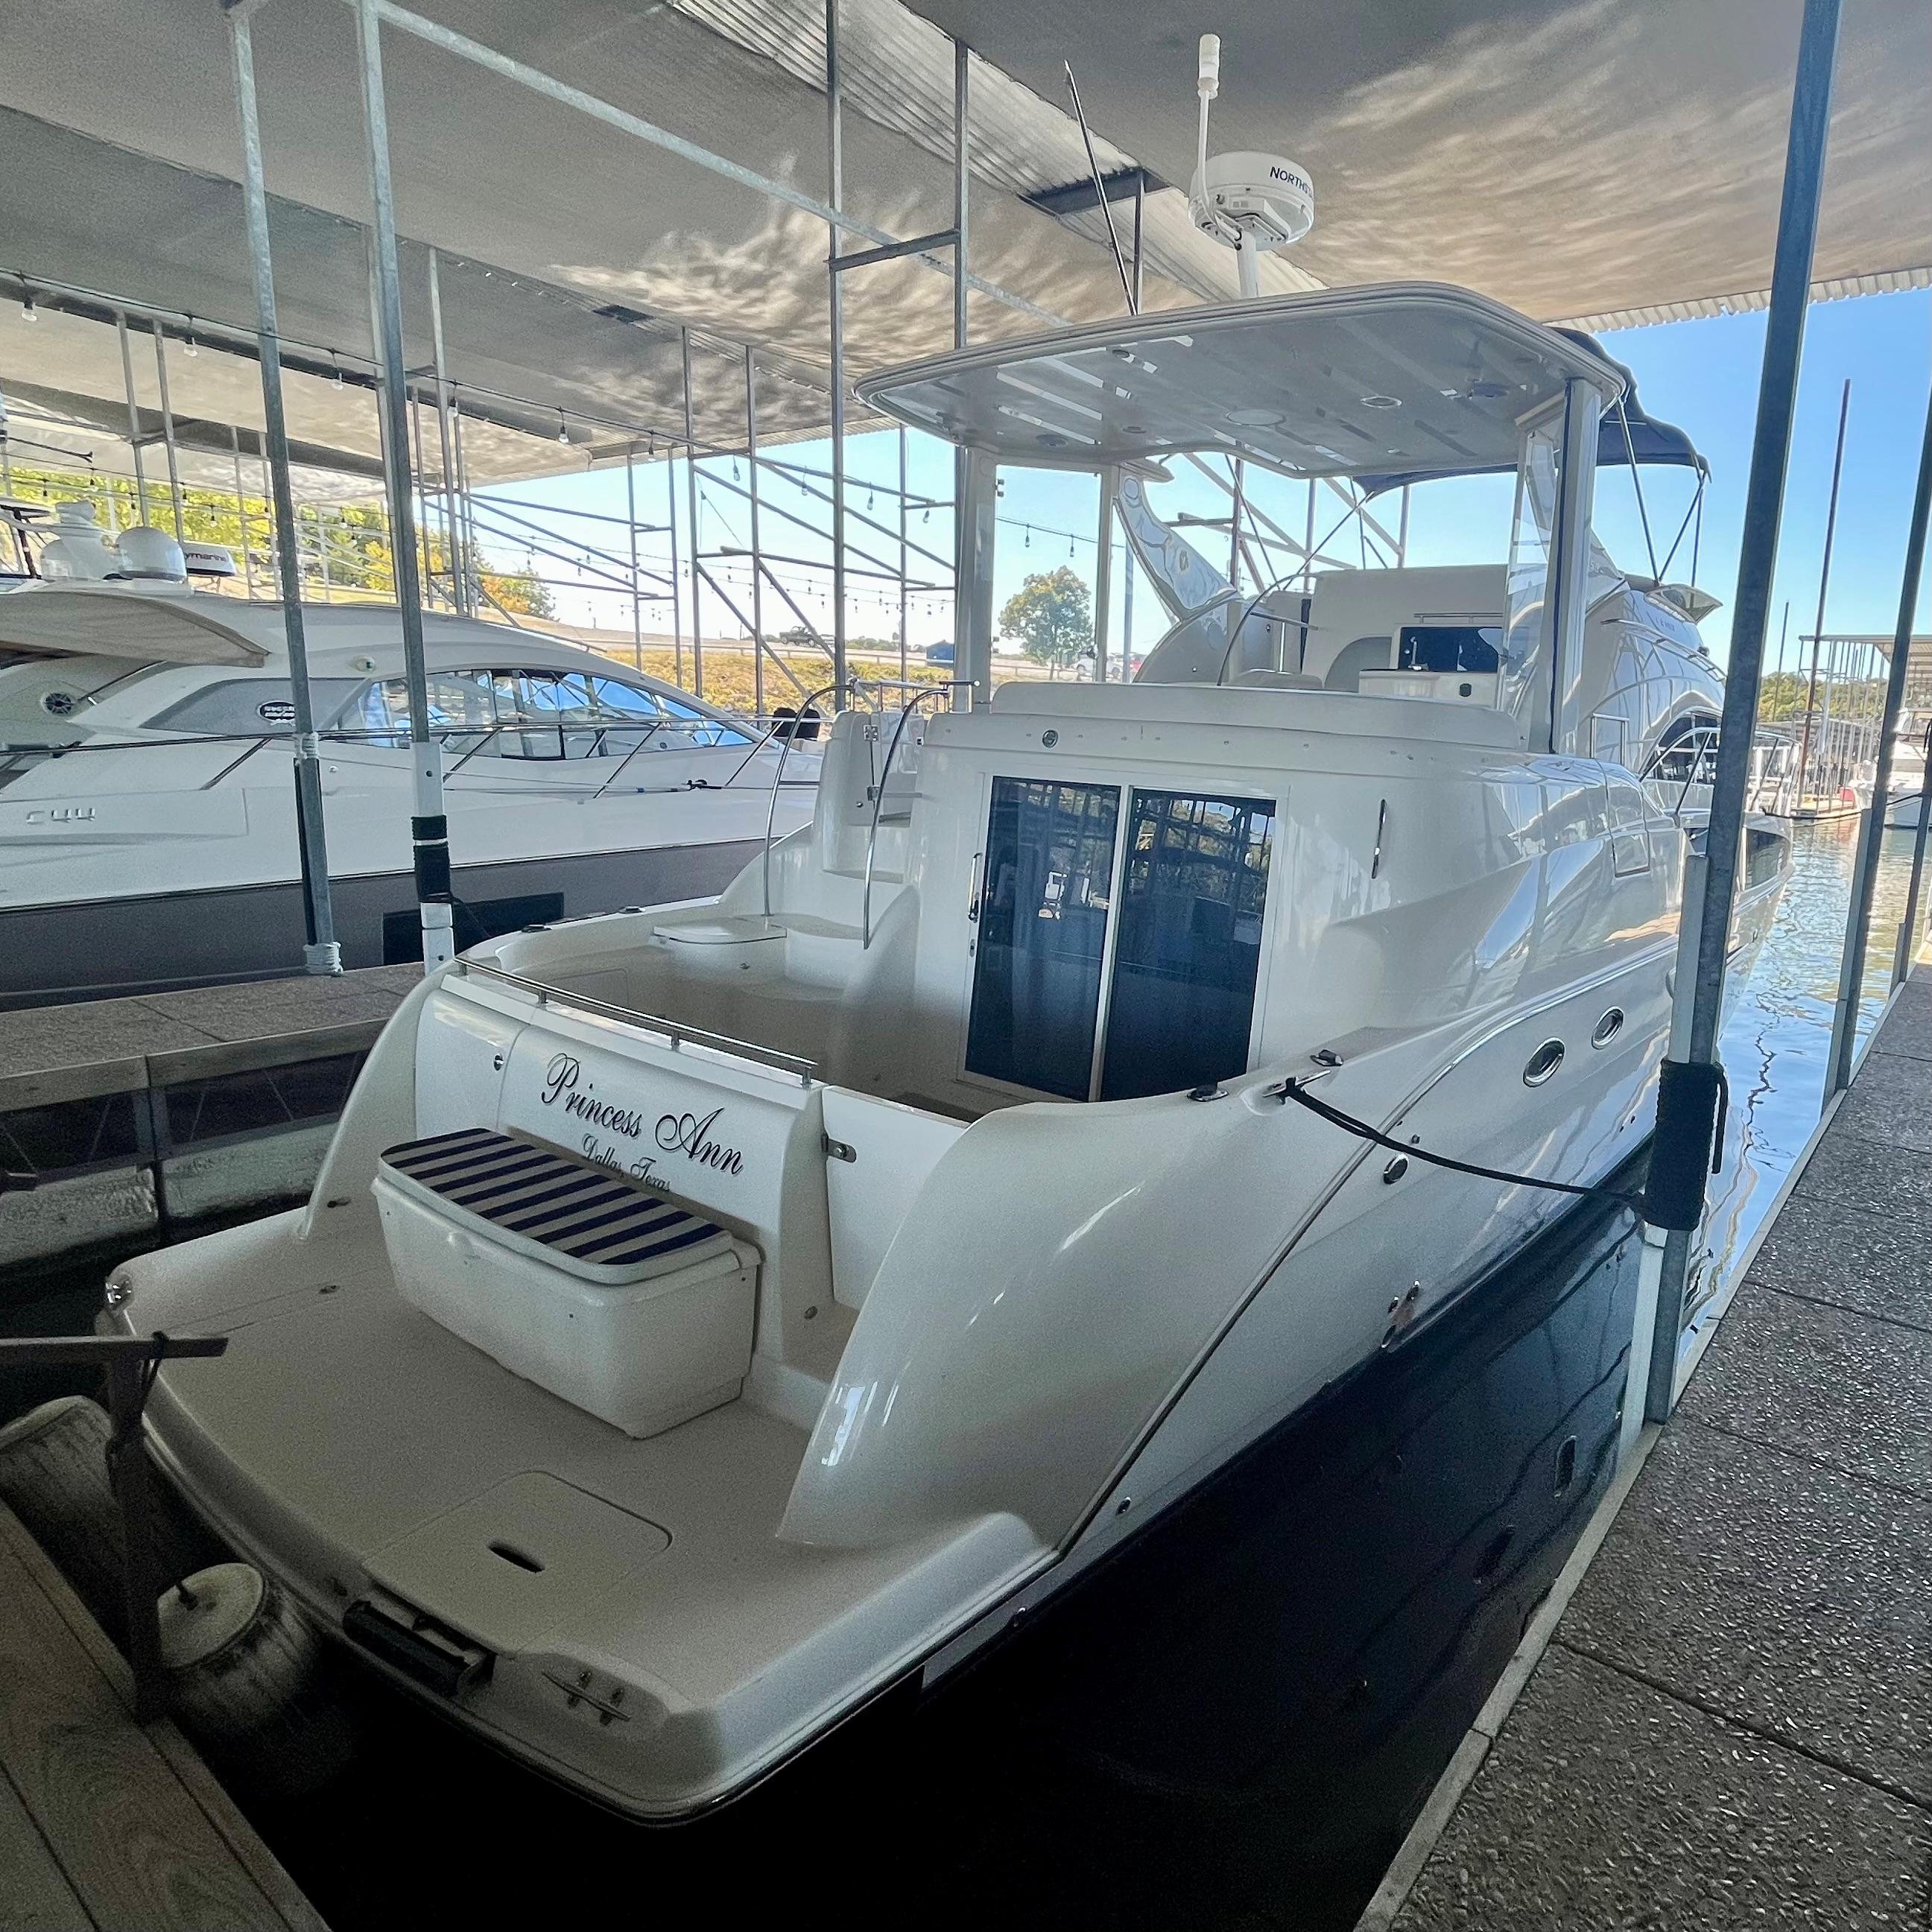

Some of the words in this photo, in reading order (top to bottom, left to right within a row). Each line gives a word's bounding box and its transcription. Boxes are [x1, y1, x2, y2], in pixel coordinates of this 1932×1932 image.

[1270, 166, 1313, 199] NORTHST
[183, 552, 227, 563] ymarine
[541, 1052, 642, 1139] Princess
[654, 1107, 744, 1176] Ann
